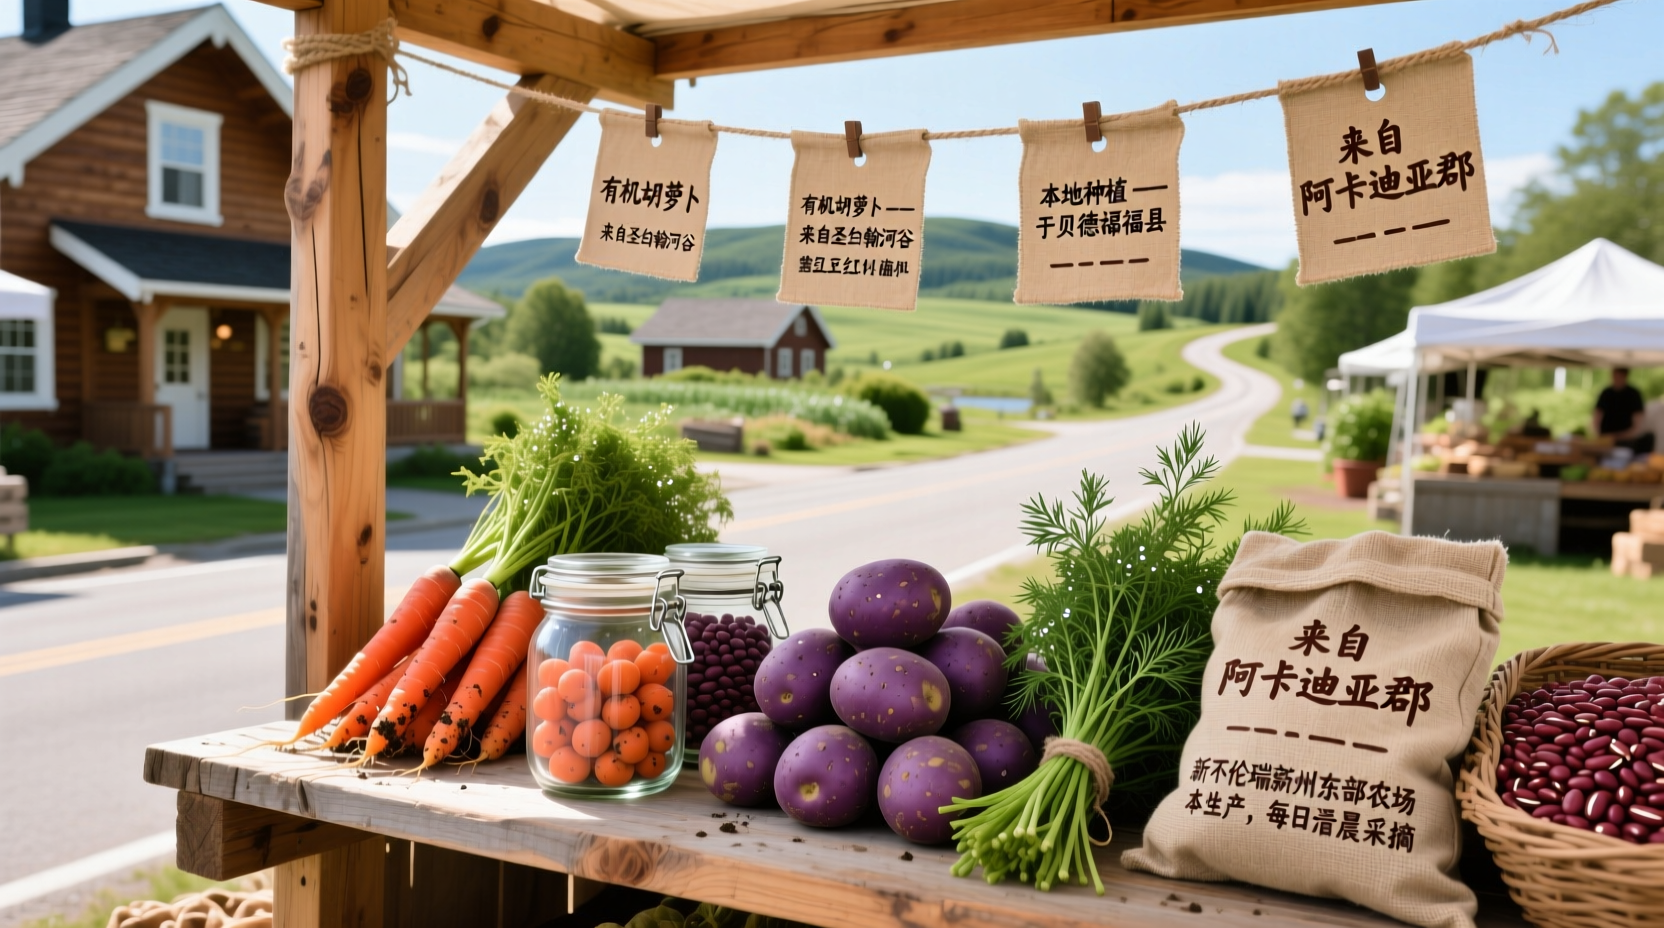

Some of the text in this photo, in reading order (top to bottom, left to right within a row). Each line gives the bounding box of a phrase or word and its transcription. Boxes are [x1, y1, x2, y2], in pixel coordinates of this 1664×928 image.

[1338, 118, 1402, 165] 来自
[601, 176, 699, 213] 有机胡萝卜
[1299, 150, 1475, 217] 阿卡迪亚郡
[1288, 619, 1370, 662] 来自
[1217, 658, 1434, 727] 阿卡迪亚郡
